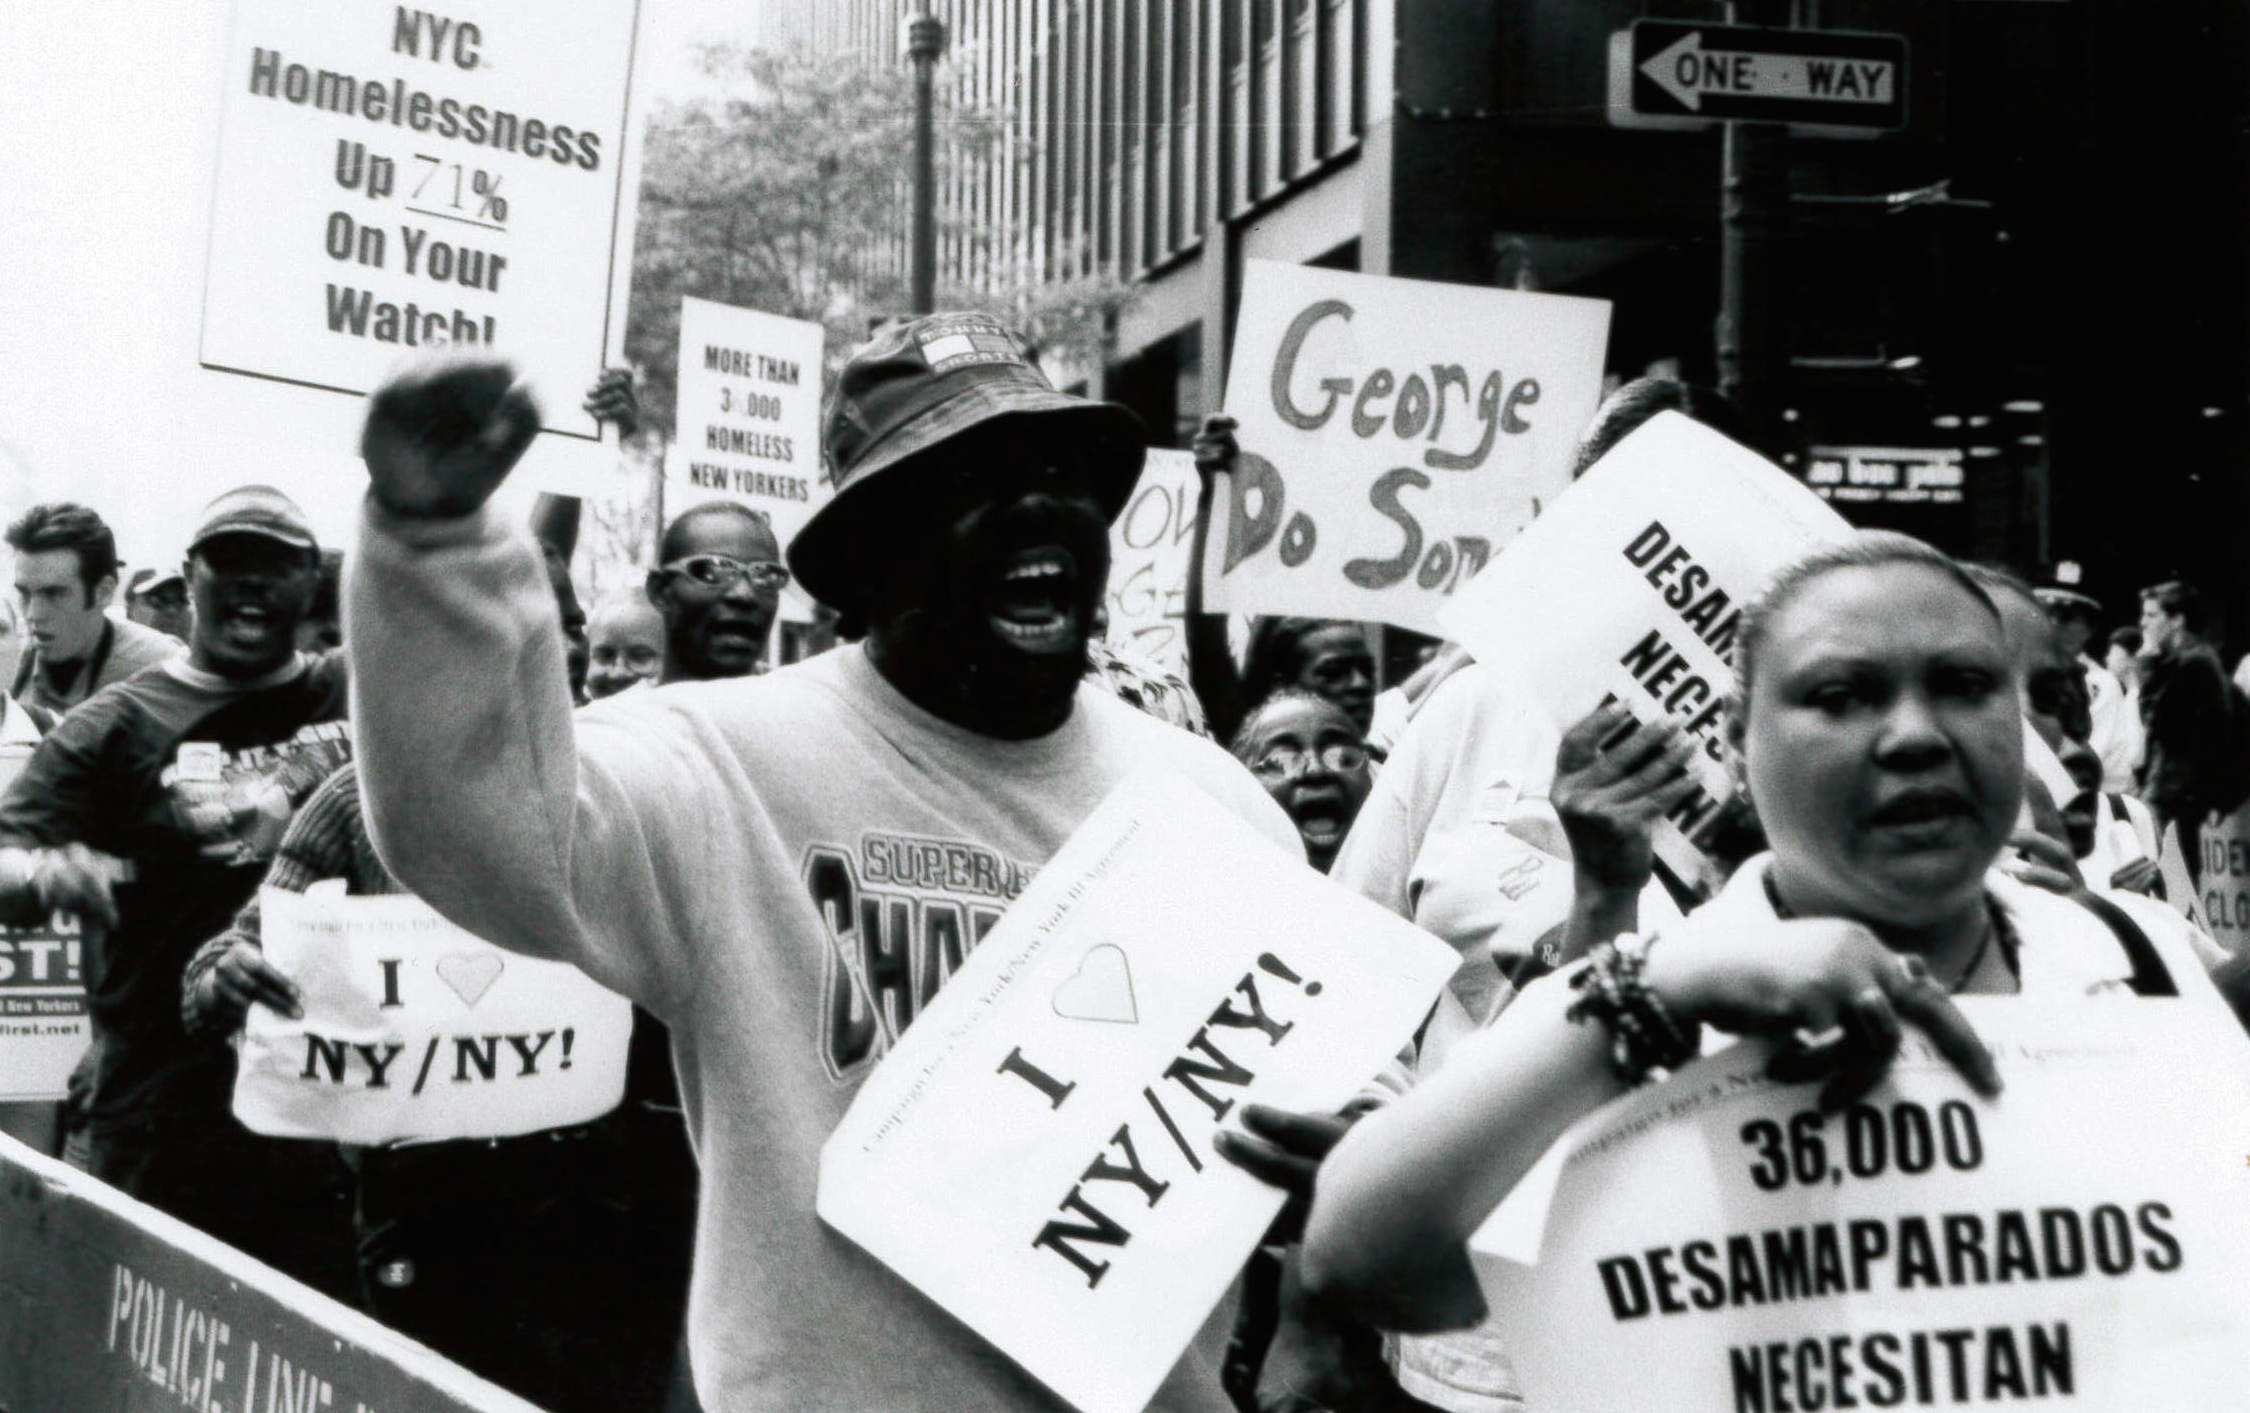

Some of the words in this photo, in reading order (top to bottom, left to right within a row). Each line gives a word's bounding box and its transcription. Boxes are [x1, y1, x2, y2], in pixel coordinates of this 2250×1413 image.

[391, 5, 482, 70] NYC
[1674, 52, 1754, 91] ONE
[1806, 60, 1886, 99] WAY
[249, 46, 602, 171] Homelessness
[335, 138, 394, 199] Up
[410, 154, 509, 223] 71%
[326, 211, 386, 269] On
[400, 225, 507, 294] Your
[704, 345, 751, 378] MORE
[758, 355, 800, 386] THAN
[1271, 299, 1542, 471] George
[690, 463, 728, 490] NEW
[733, 469, 809, 503] YORKERS
[706, 424, 793, 463] HOMELESS
[1222, 451, 1317, 577] Do
[862, 837, 1001, 897] SUPER
[378, 958, 405, 1010] I
[299, 1027, 577, 1097] NY/NY!
[996, 1046, 1077, 1111] I
[1031, 952, 1323, 1290] NY/NY!
[1741, 1098, 1985, 1192] 36,000
[1596, 1201, 2184, 1322] DESAMAPARADOS
[109, 1263, 230, 1413] POLICE
[1729, 1322, 2077, 1413] NECESITAN
